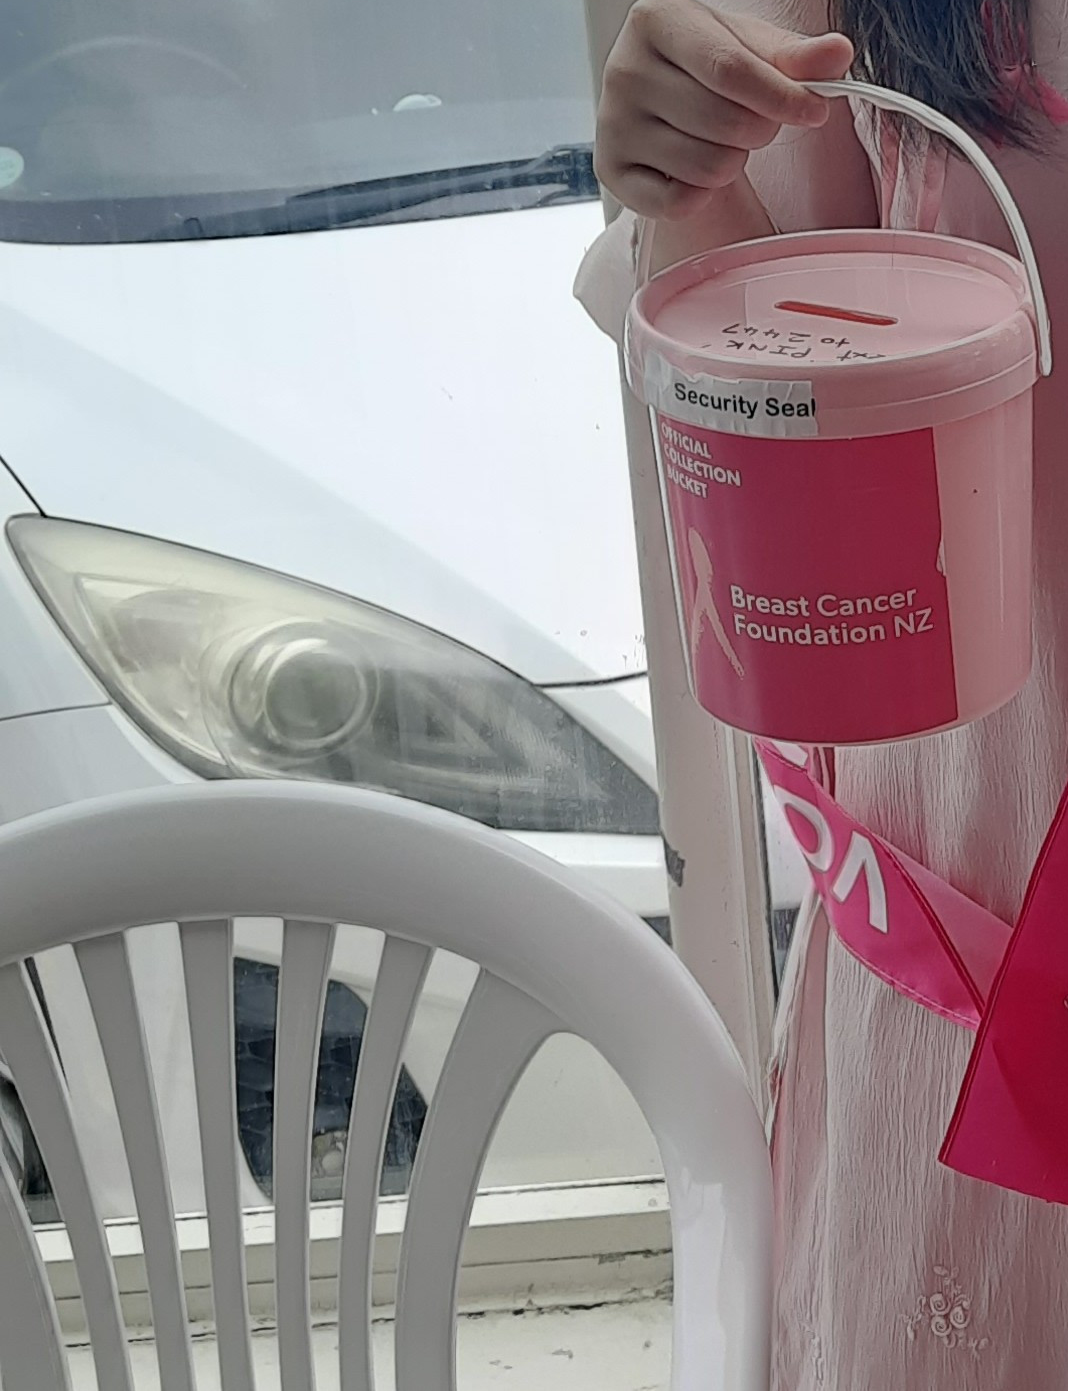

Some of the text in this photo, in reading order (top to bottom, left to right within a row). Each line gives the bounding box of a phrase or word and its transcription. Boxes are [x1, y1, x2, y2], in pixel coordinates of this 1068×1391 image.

[721, 323, 851, 348] to 2447
[674, 383, 817, 419] Security Seal
[661, 421, 713, 460] OFFICIAL
[663, 443, 742, 487] COLLECTION
[666, 463, 708, 499] BUCKET
[730, 584, 917, 617] Breast Cancer
[733, 607, 934, 646] Foundation NZ
